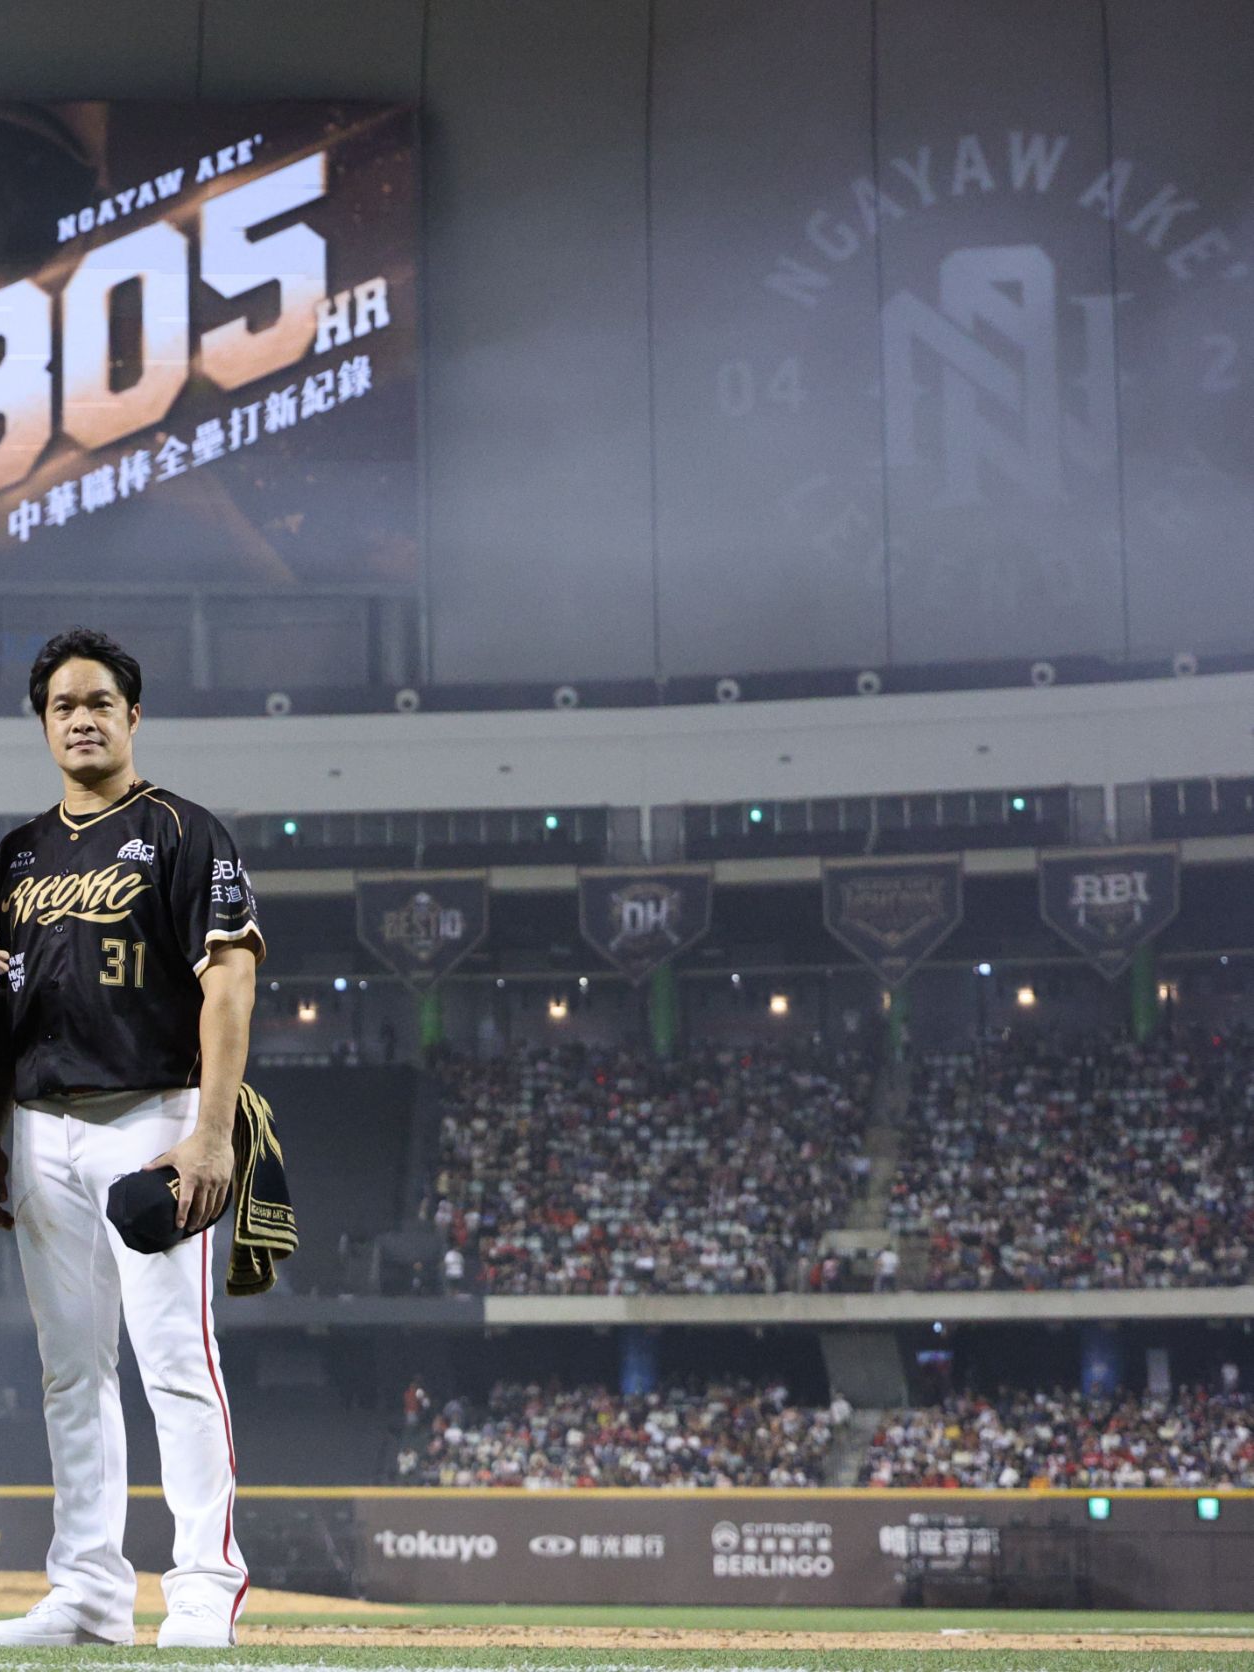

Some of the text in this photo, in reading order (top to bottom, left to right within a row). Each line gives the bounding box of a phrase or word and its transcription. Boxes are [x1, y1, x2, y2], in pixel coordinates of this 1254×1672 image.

[57, 167, 185, 243] NGAYAW
[764, 131, 1070, 309] NGAYAW
[315, 276, 390, 355] HR
[8, 355, 372, 542] 中華職棒全壘打新紀錄
[99, 937, 146, 988] 31
[375, 1529, 498, 1563] tokuyo
[712, 1554, 835, 1577] BERLINGO
